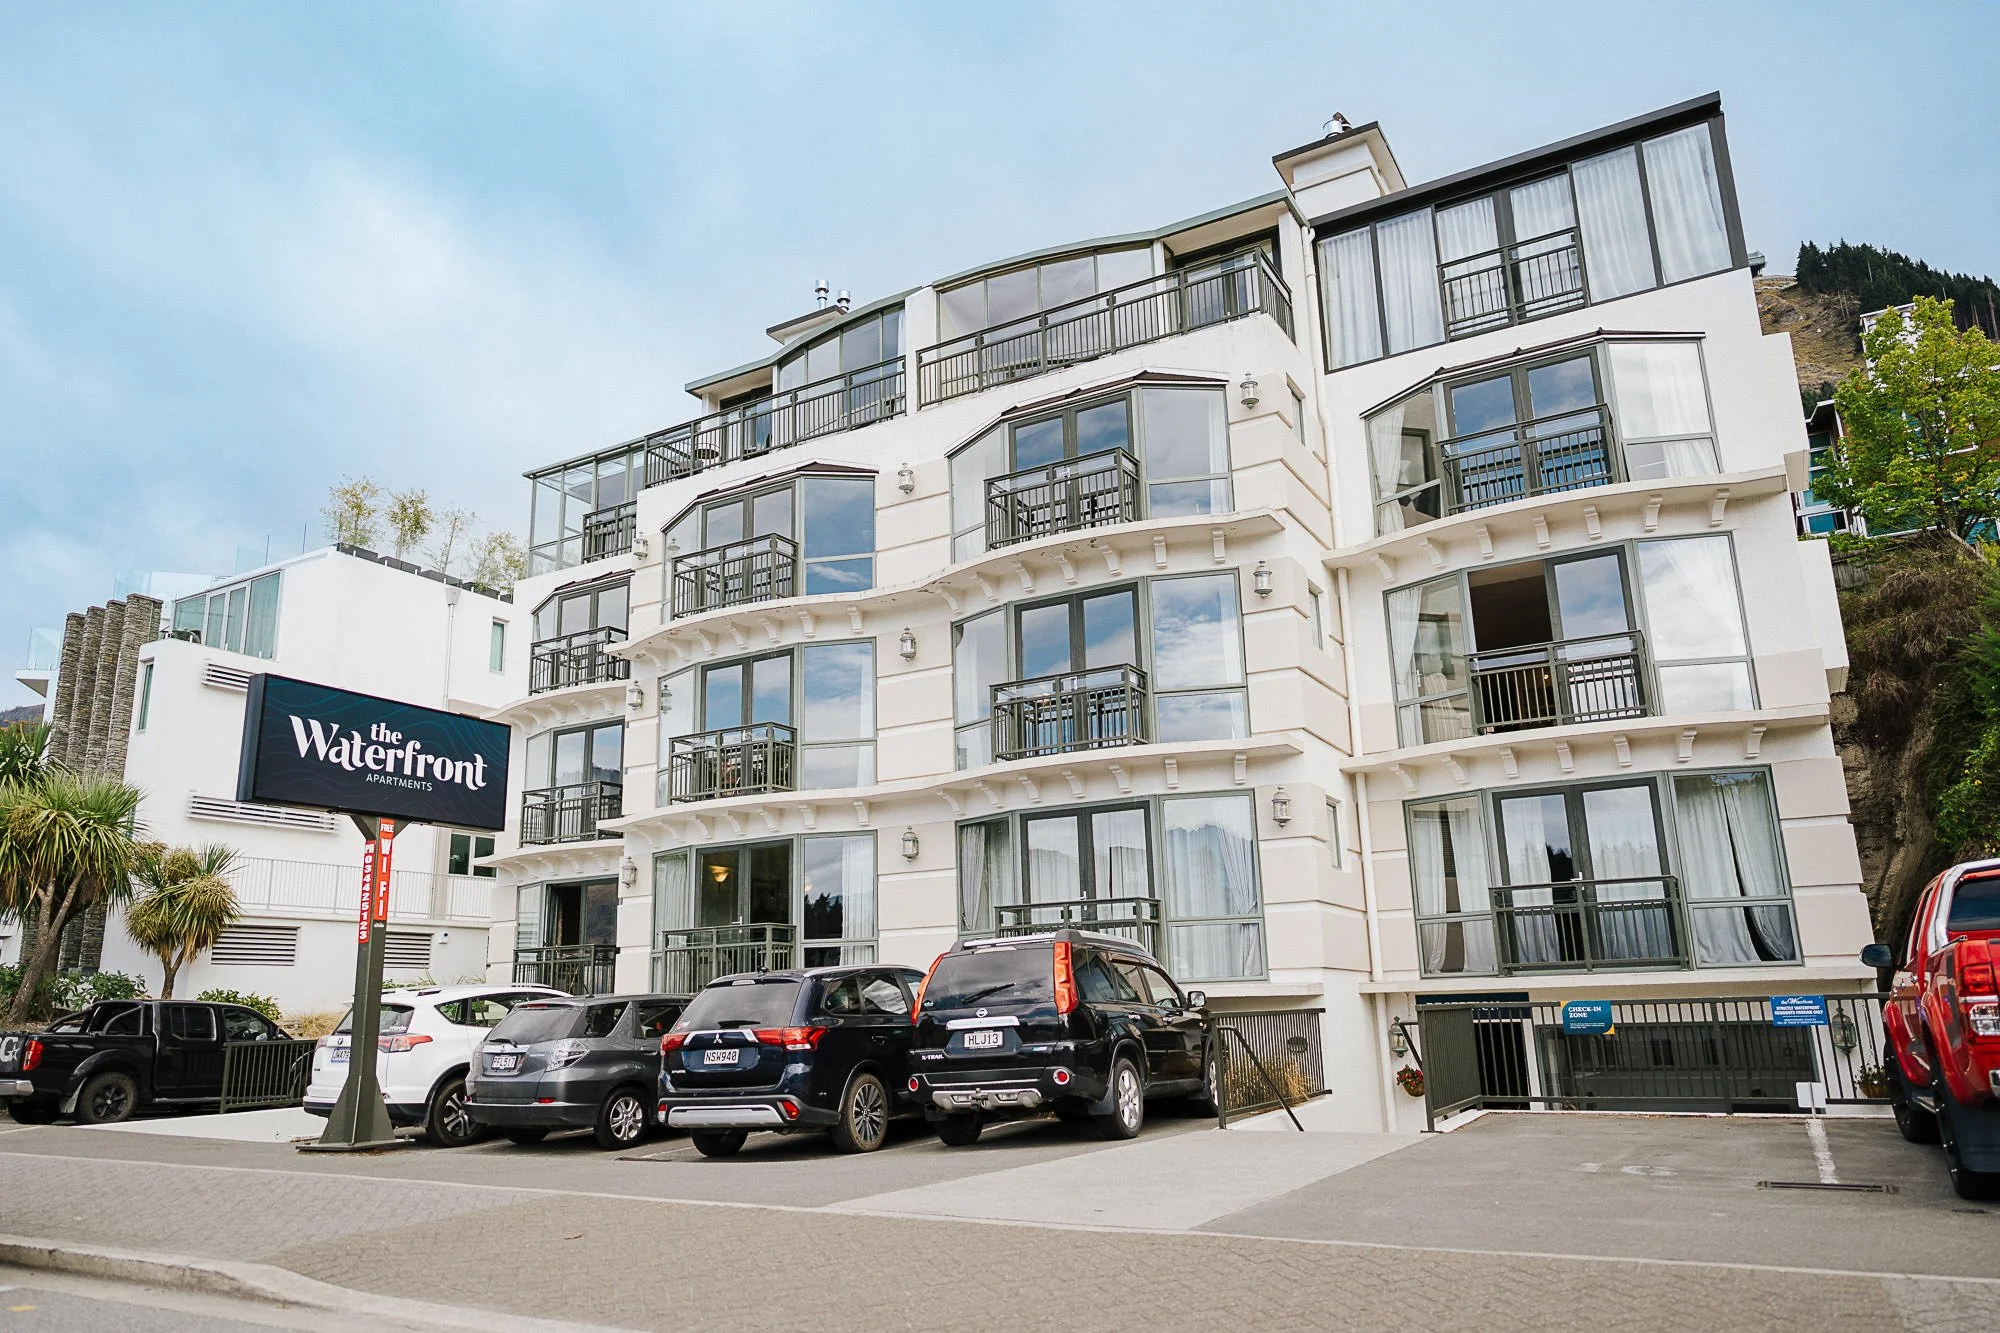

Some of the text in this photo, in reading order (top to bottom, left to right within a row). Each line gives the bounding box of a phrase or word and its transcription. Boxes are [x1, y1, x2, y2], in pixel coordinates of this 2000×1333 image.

[370, 722, 402, 744] the
[288, 714, 488, 790] Waterfront
[366, 773, 433, 791] APARTMENTS
[381, 823, 395, 833] FREE
[968, 1034, 999, 1045] HLJ13
[705, 1051, 737, 1062] NSW940
